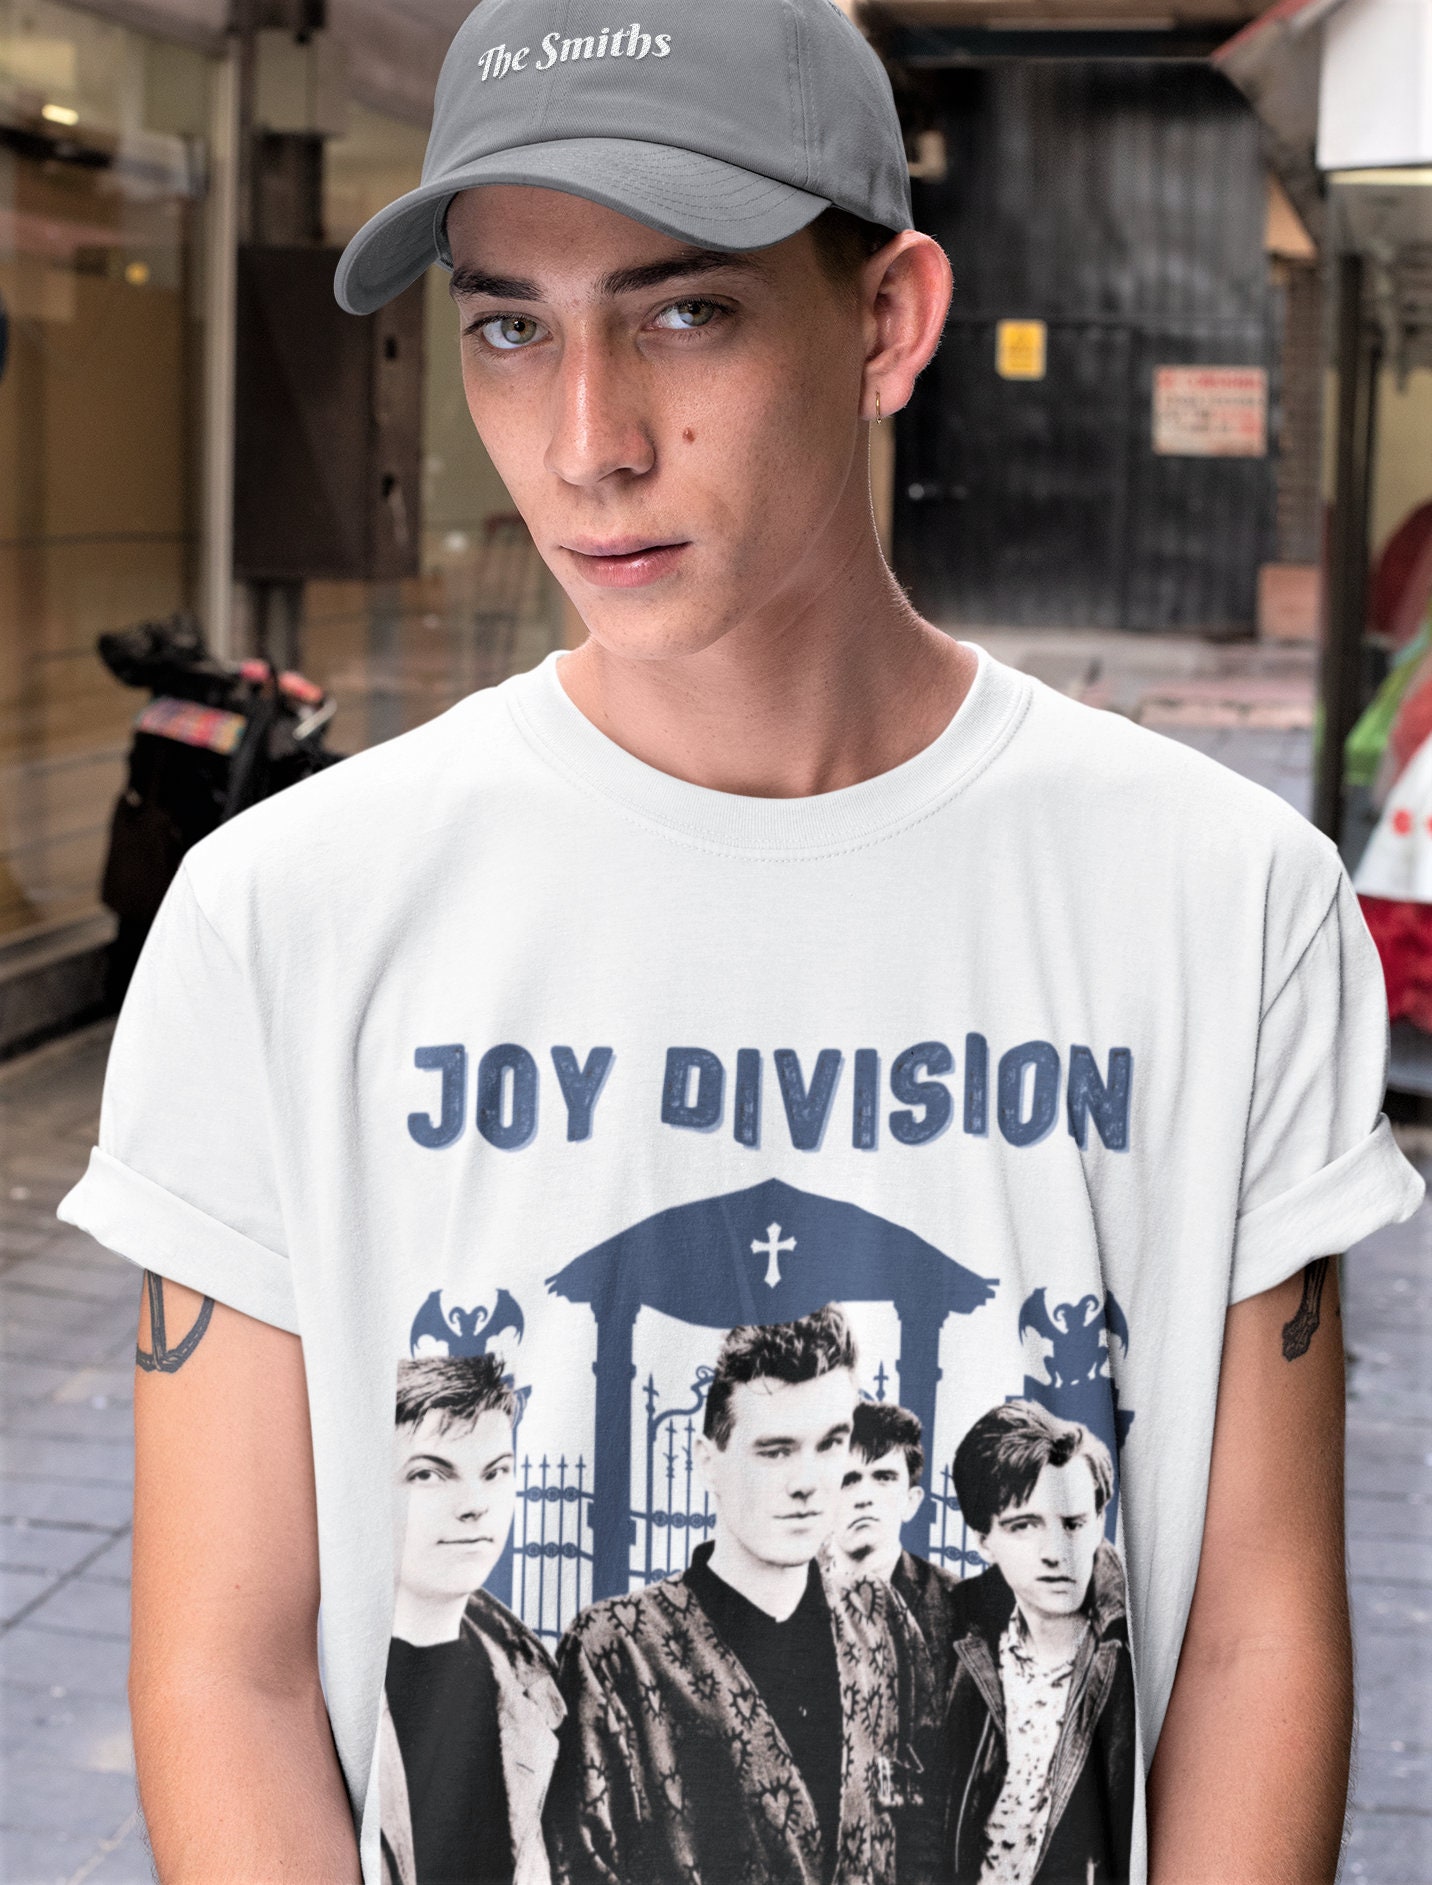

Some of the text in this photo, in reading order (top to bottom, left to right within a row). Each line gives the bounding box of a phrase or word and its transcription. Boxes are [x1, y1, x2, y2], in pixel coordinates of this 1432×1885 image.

[478, 23, 671, 81] The Smiths
[407, 1032, 1133, 1153] JOY DIVISION
